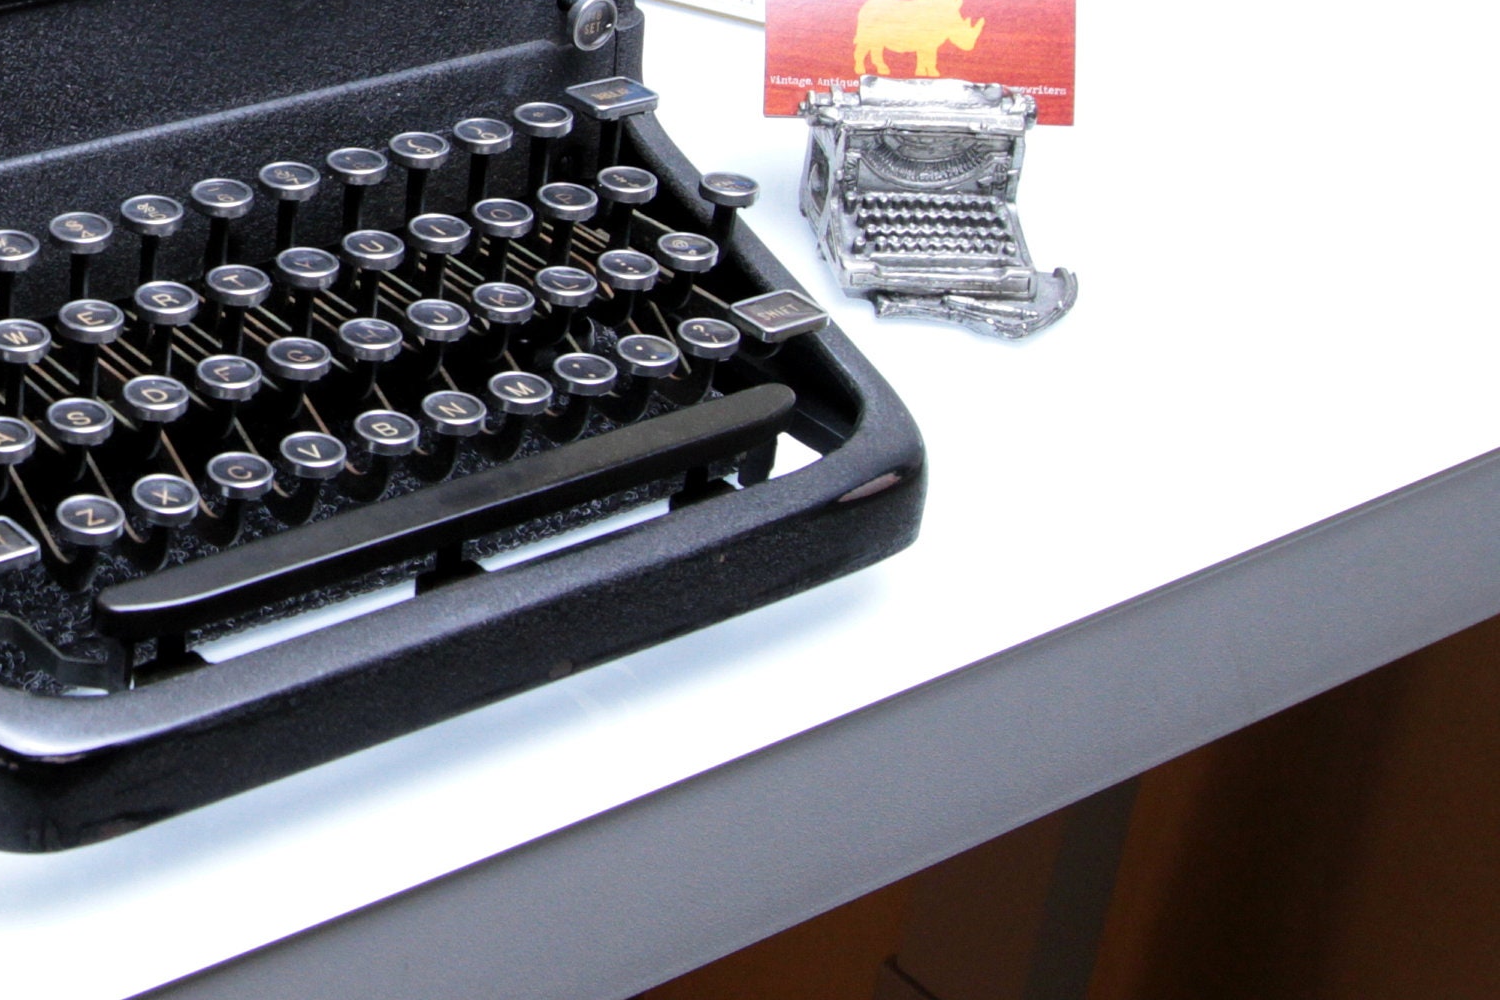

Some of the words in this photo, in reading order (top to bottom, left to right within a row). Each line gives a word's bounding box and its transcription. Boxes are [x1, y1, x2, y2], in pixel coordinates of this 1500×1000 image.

[818, 77, 859, 89] Antique
[359, 240, 384, 252] U
[223, 274, 245, 287] T
[152, 293, 180, 307] R
[76, 311, 105, 326] E
[433, 311, 448, 323] J
[756, 303, 800, 321] SHIFT
[3, 331, 29, 345] W
[287, 351, 312, 362] G
[213, 366, 231, 381] F
[141, 388, 168, 402] D
[504, 382, 536, 397] M
[438, 401, 467, 417] N
[67, 411, 91, 426] S
[371, 422, 398, 437] B
[297, 444, 321, 459] V
[228, 466, 252, 479] C
[152, 482, 179, 505] X
[75, 508, 105, 526] Z
